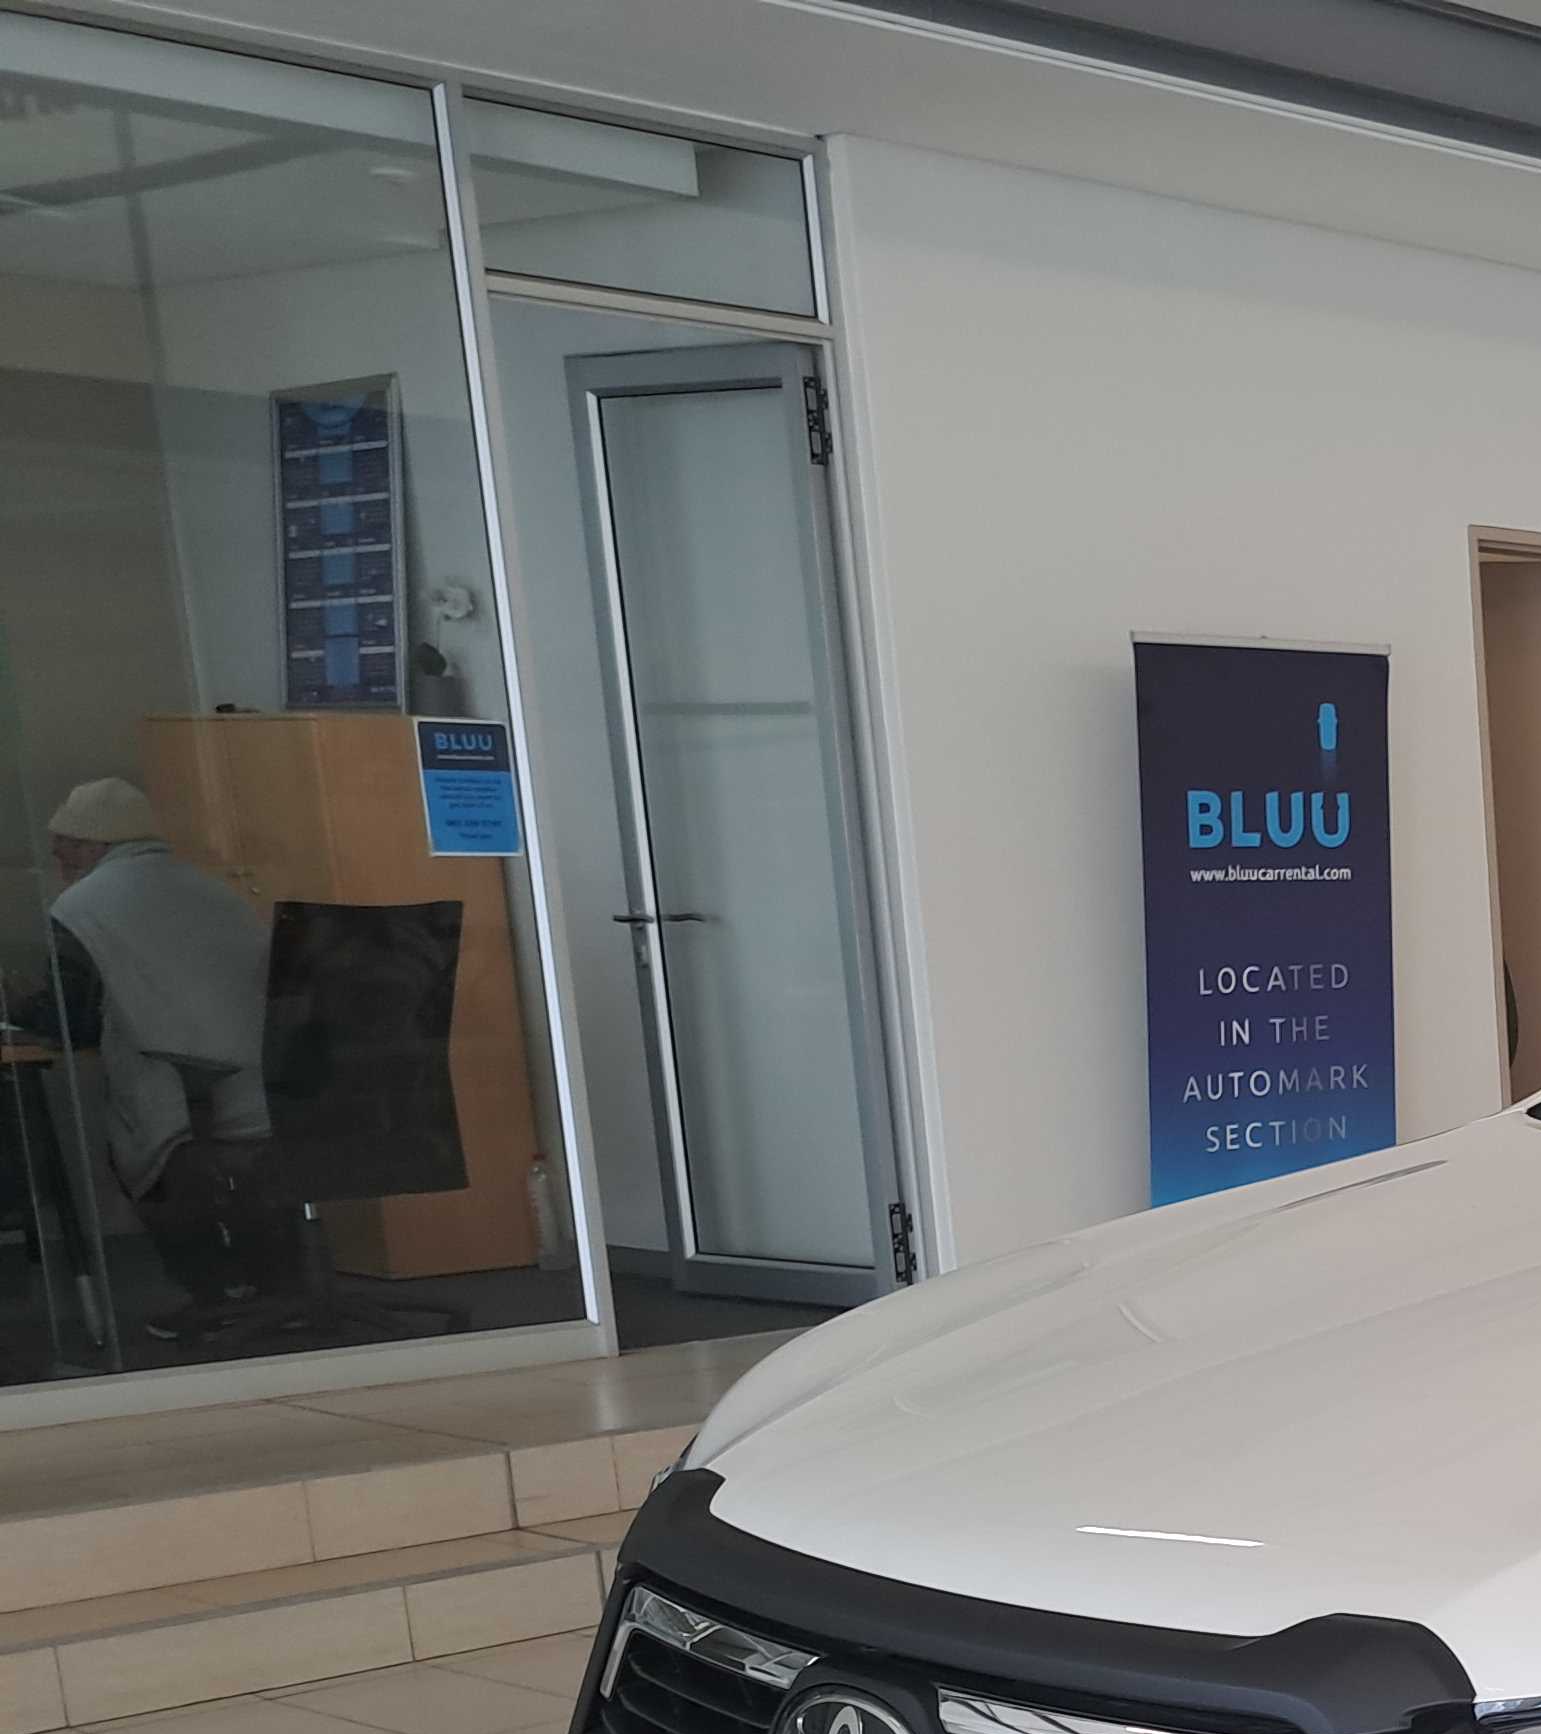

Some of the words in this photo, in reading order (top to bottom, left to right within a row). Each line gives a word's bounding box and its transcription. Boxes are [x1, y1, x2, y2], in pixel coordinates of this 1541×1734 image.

[434, 733, 492, 751] BLUU
[1186, 789, 1352, 850] BLUU
[1190, 865, 1352, 882] www.bluucarrental.com
[1199, 963, 1350, 996] LOCATED
[1219, 1019, 1250, 1047] IN
[1269, 1015, 1330, 1043] THE
[1183, 1063, 1369, 1104] AUTOMARK
[1205, 1115, 1347, 1153] SECTION
